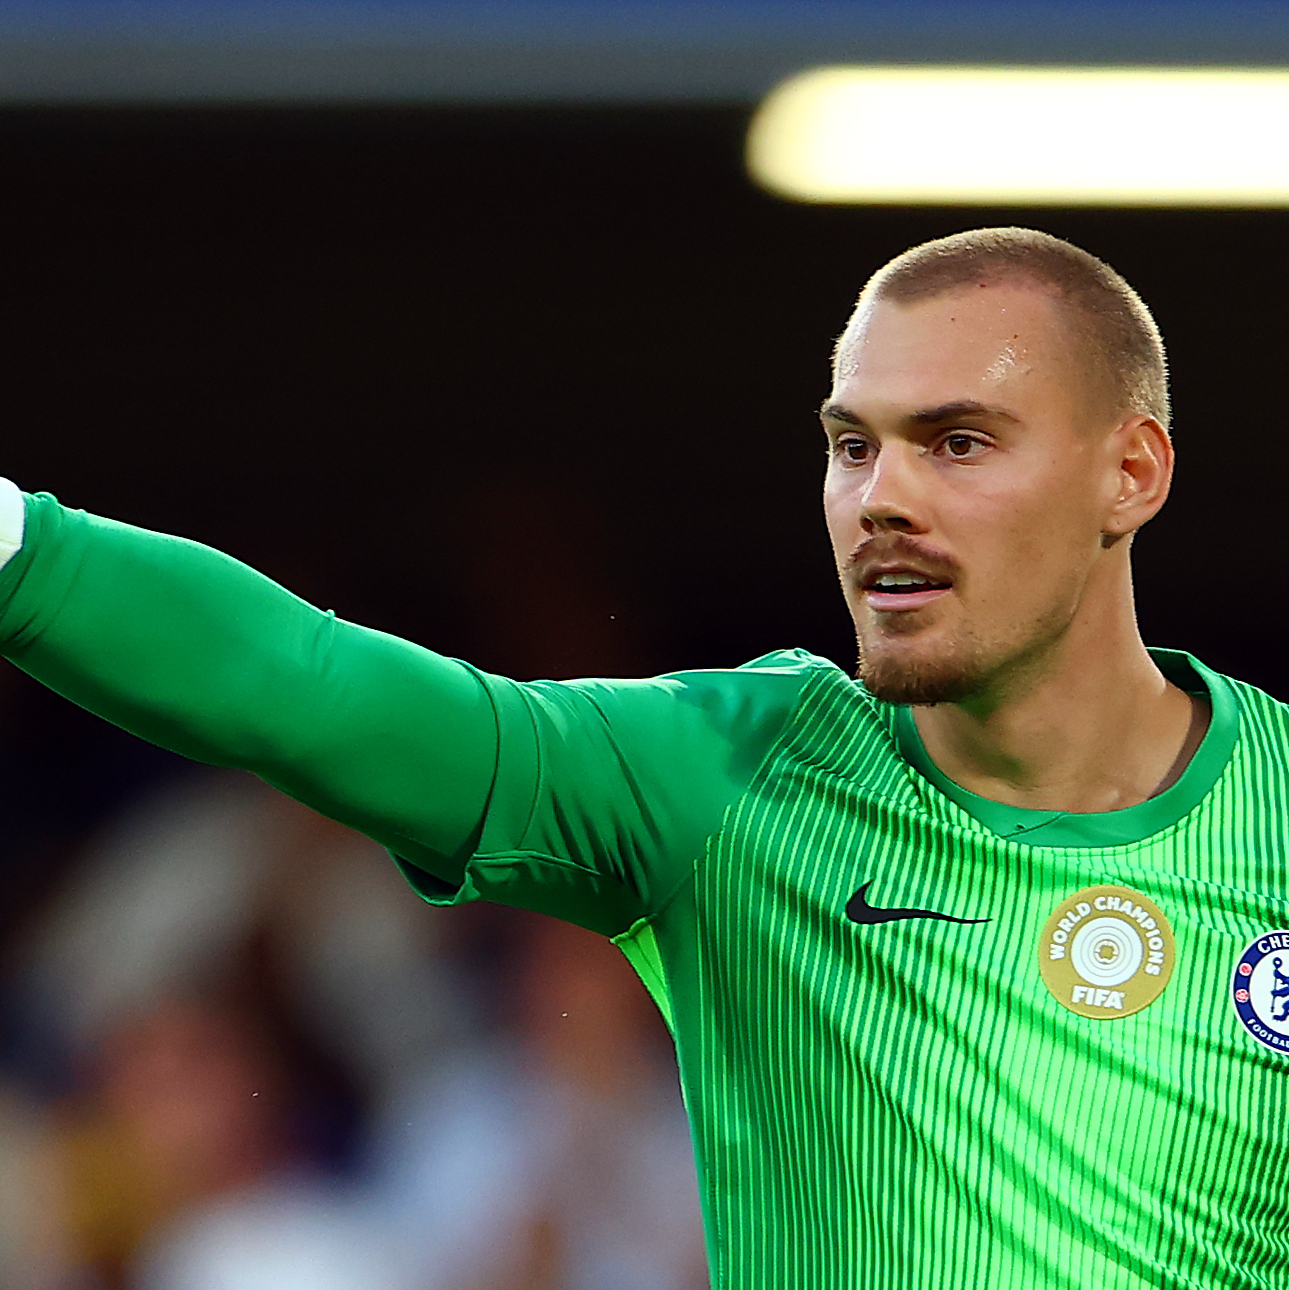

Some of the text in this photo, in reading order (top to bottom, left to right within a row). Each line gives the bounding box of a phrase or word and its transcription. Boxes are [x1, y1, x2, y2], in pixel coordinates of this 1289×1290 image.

[1049, 896, 1166, 976] WORLD CHAMPIONS
[1071, 985, 1125, 1010] FIFA
